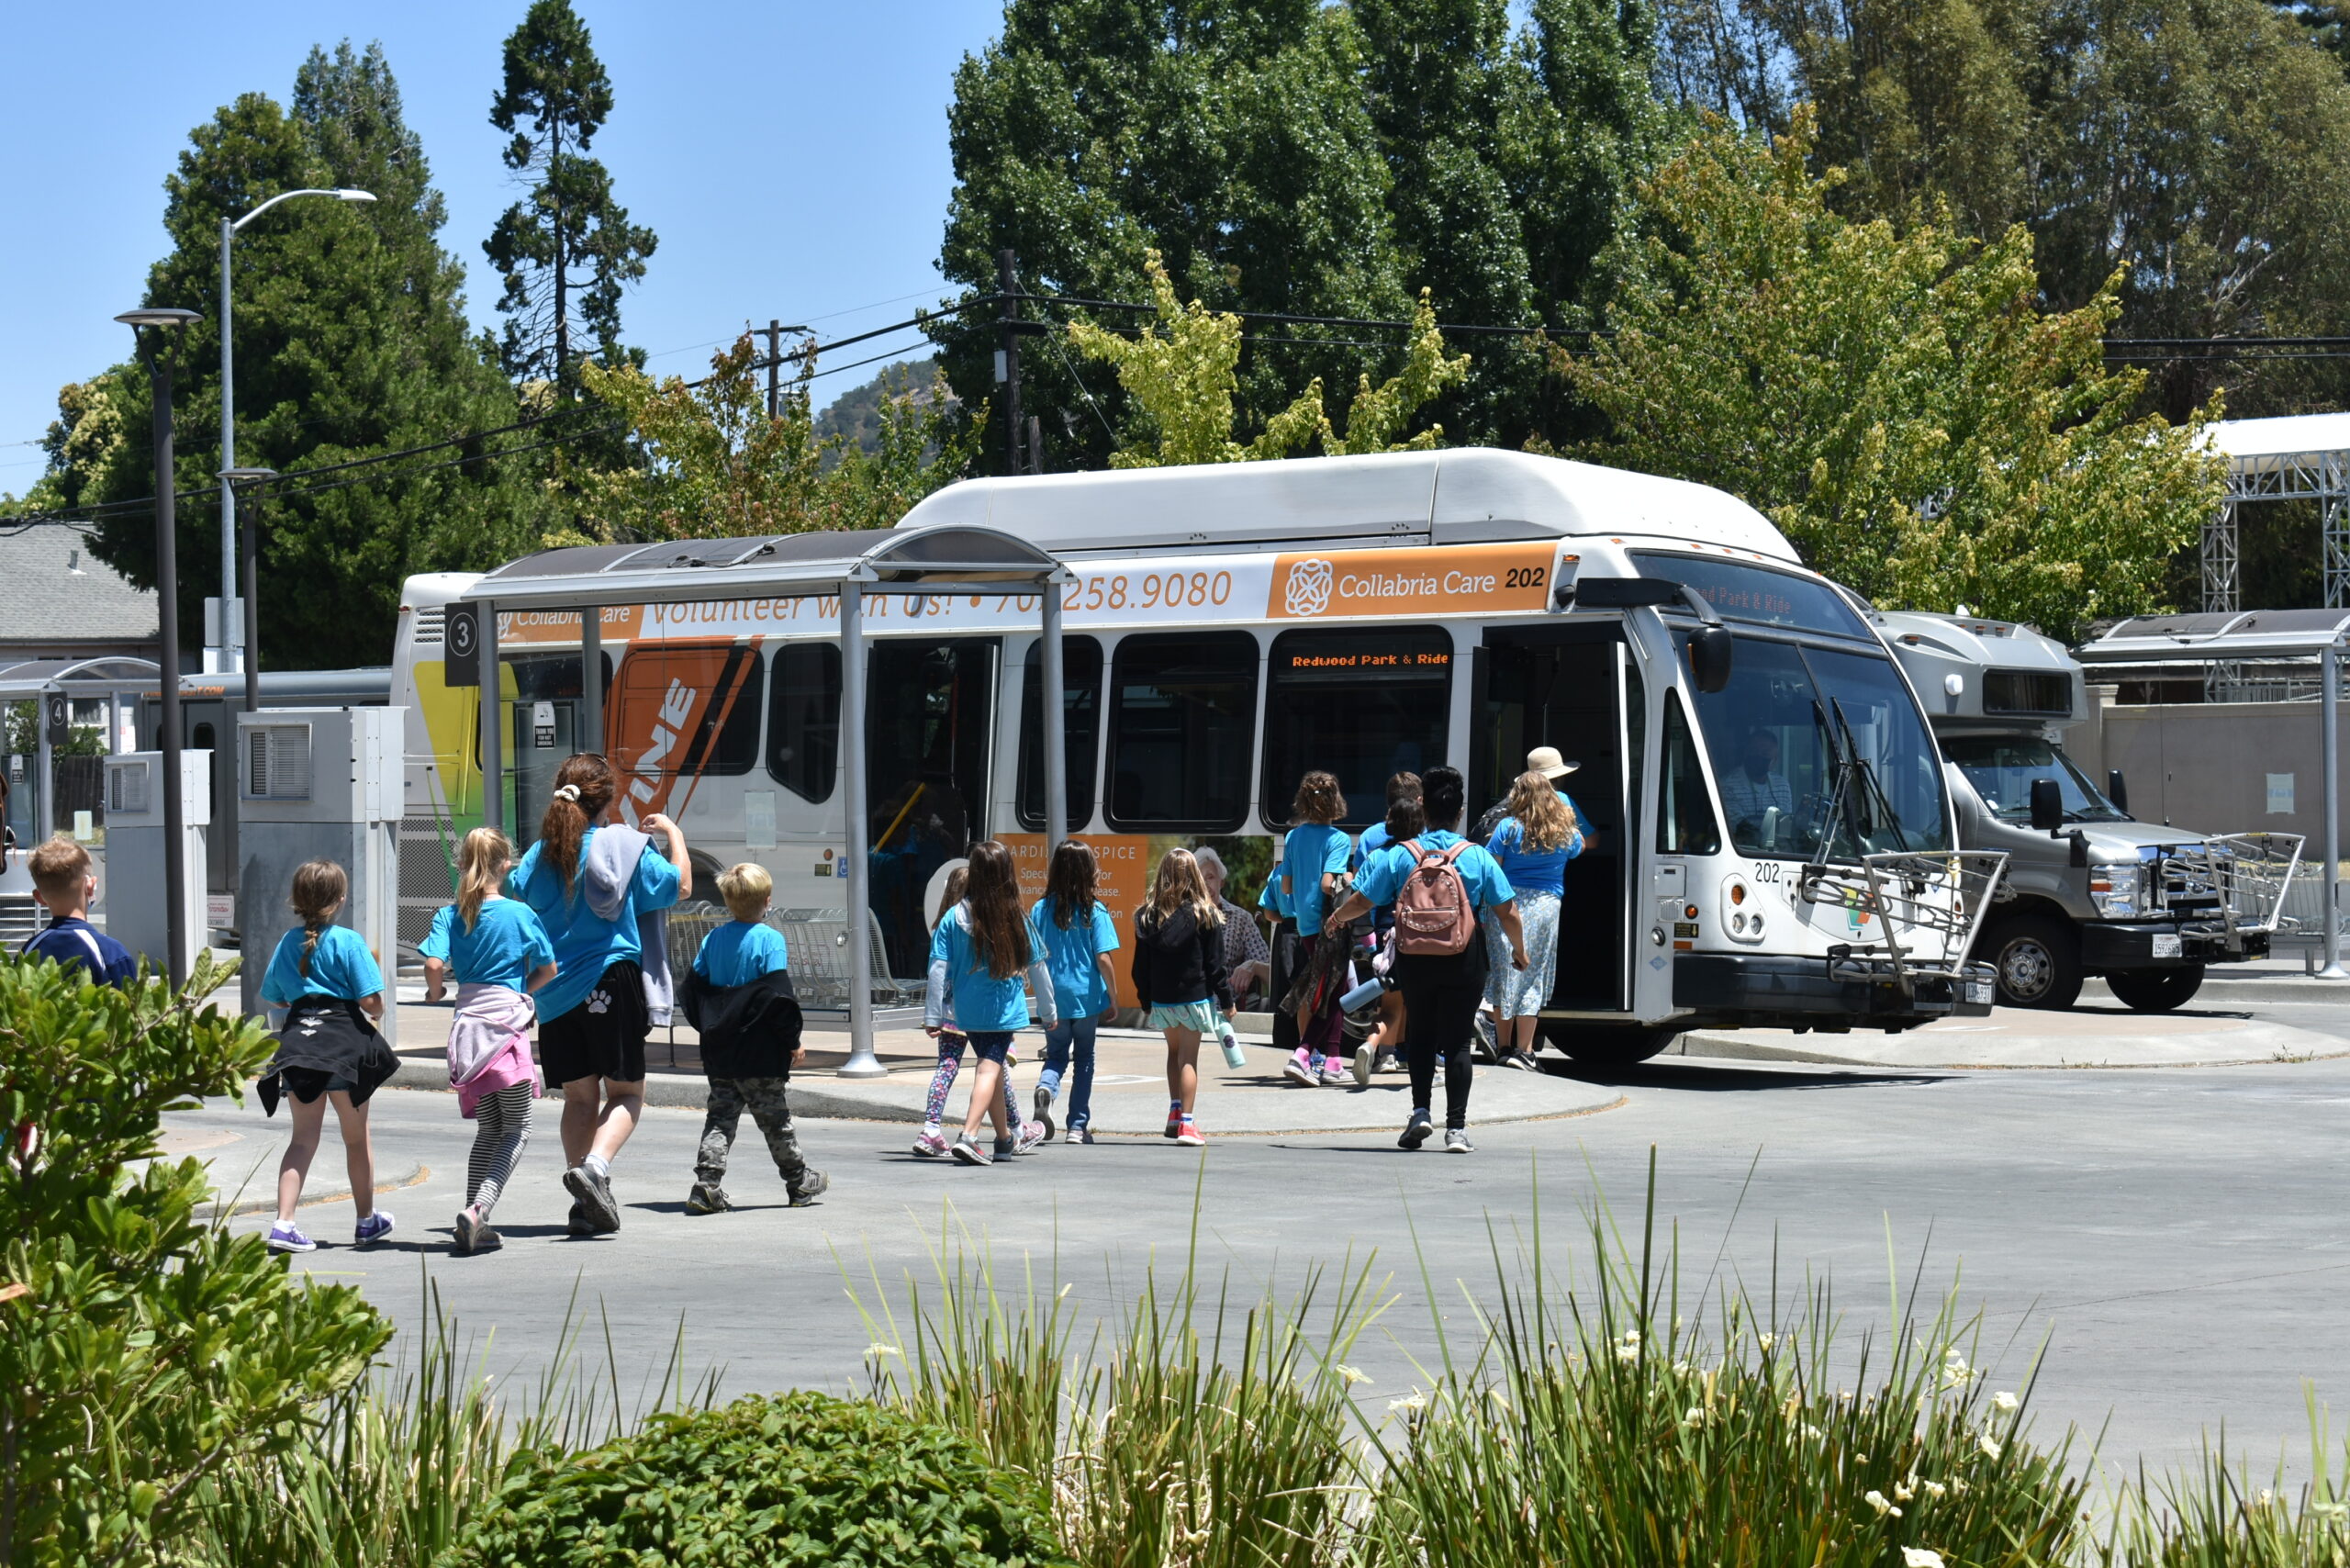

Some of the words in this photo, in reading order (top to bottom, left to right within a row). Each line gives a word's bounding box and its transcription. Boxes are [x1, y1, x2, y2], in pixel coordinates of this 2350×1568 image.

[1338, 572, 1438, 598] Collabria
[1443, 570, 1496, 594] Care
[1505, 567, 1546, 588] 202
[517, 611, 583, 626] Collabri
[599, 606, 631, 622] are
[654, 597, 804, 624] Volunteer
[816, 595, 888, 619] wh
[456, 621, 470, 647] 3
[1292, 655, 1356, 666] Redwood
[1360, 655, 1398, 666] Park
[1403, 654, 1412, 665] &
[1417, 654, 1449, 665] Ride
[54, 703, 62, 720] 4
[1755, 862, 1780, 883] 202
